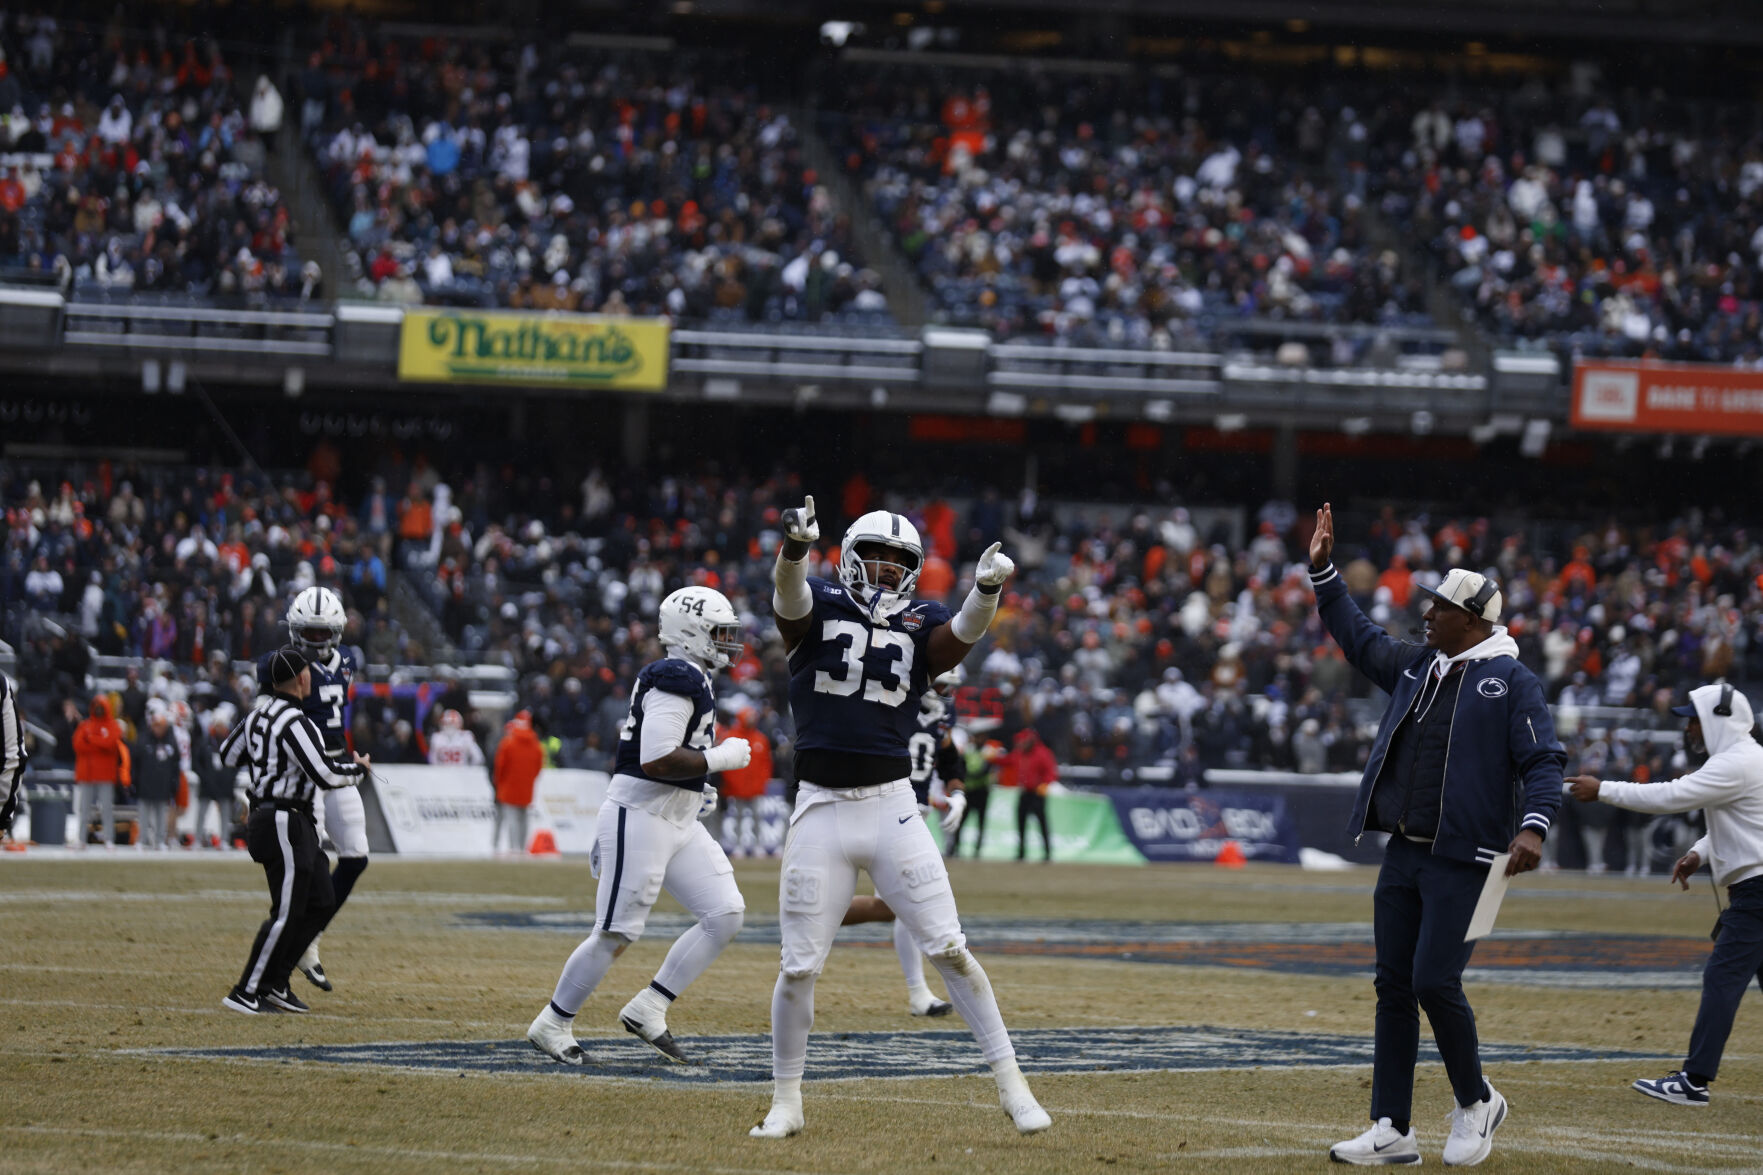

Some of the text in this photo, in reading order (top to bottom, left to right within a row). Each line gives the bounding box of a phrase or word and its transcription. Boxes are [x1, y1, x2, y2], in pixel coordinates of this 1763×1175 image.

[427, 317, 636, 364] Nathan's
[681, 596, 706, 617] 54
[814, 619, 915, 708] 33
[318, 684, 344, 728] 7
